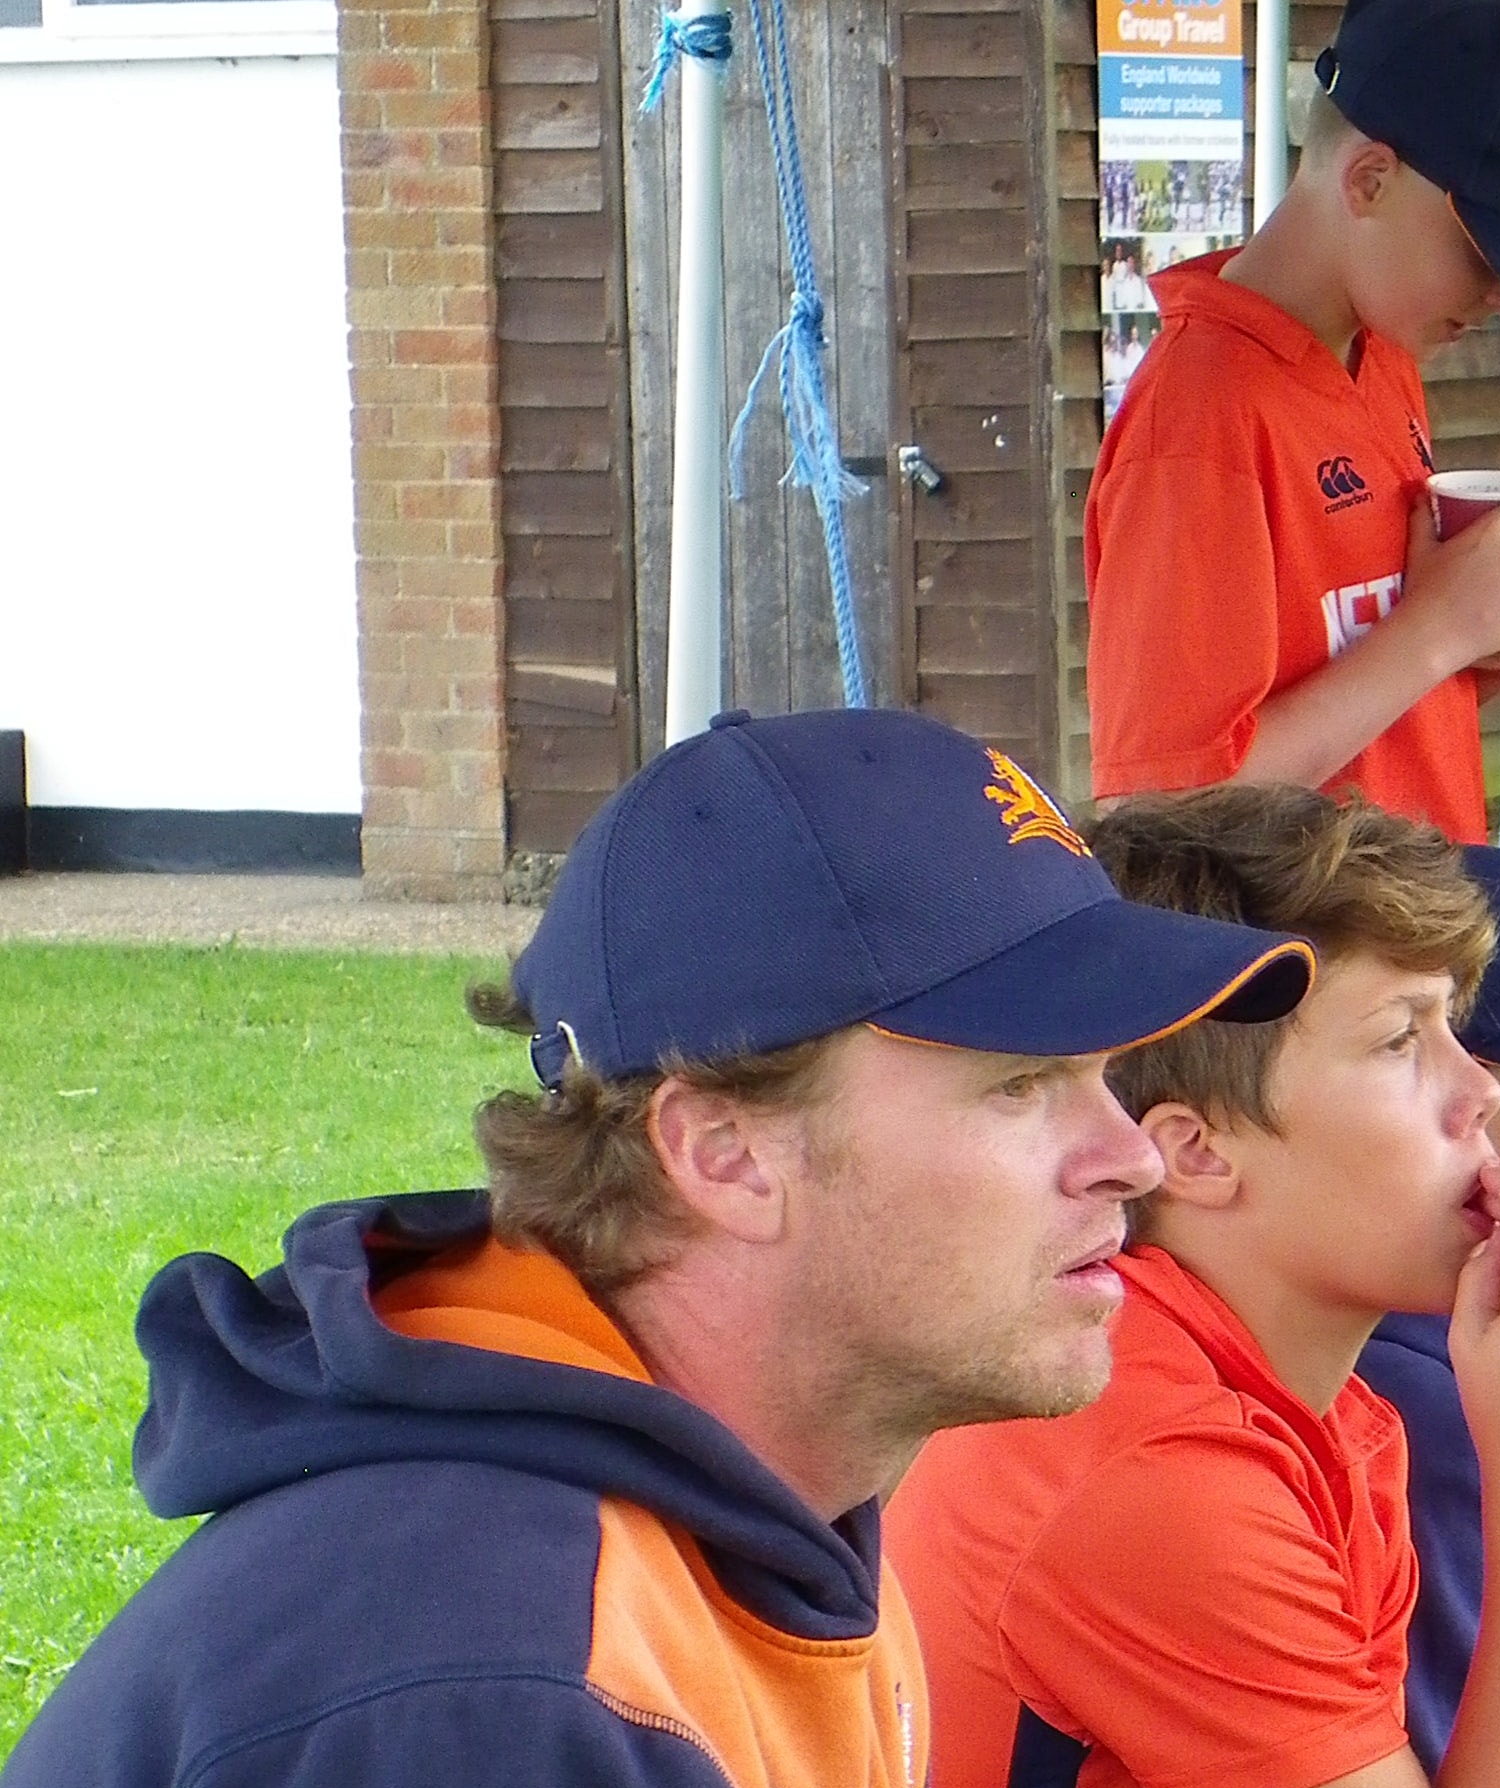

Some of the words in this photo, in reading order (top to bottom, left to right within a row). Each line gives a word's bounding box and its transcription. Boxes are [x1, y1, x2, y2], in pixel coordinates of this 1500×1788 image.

[1118, 9, 1172, 48] Group
[1173, 11, 1226, 43] Travel
[1121, 63, 1165, 88] England
[1166, 65, 1221, 85] Worldwide
[1120, 95, 1171, 116] supporter
[1173, 94, 1222, 118] packages
